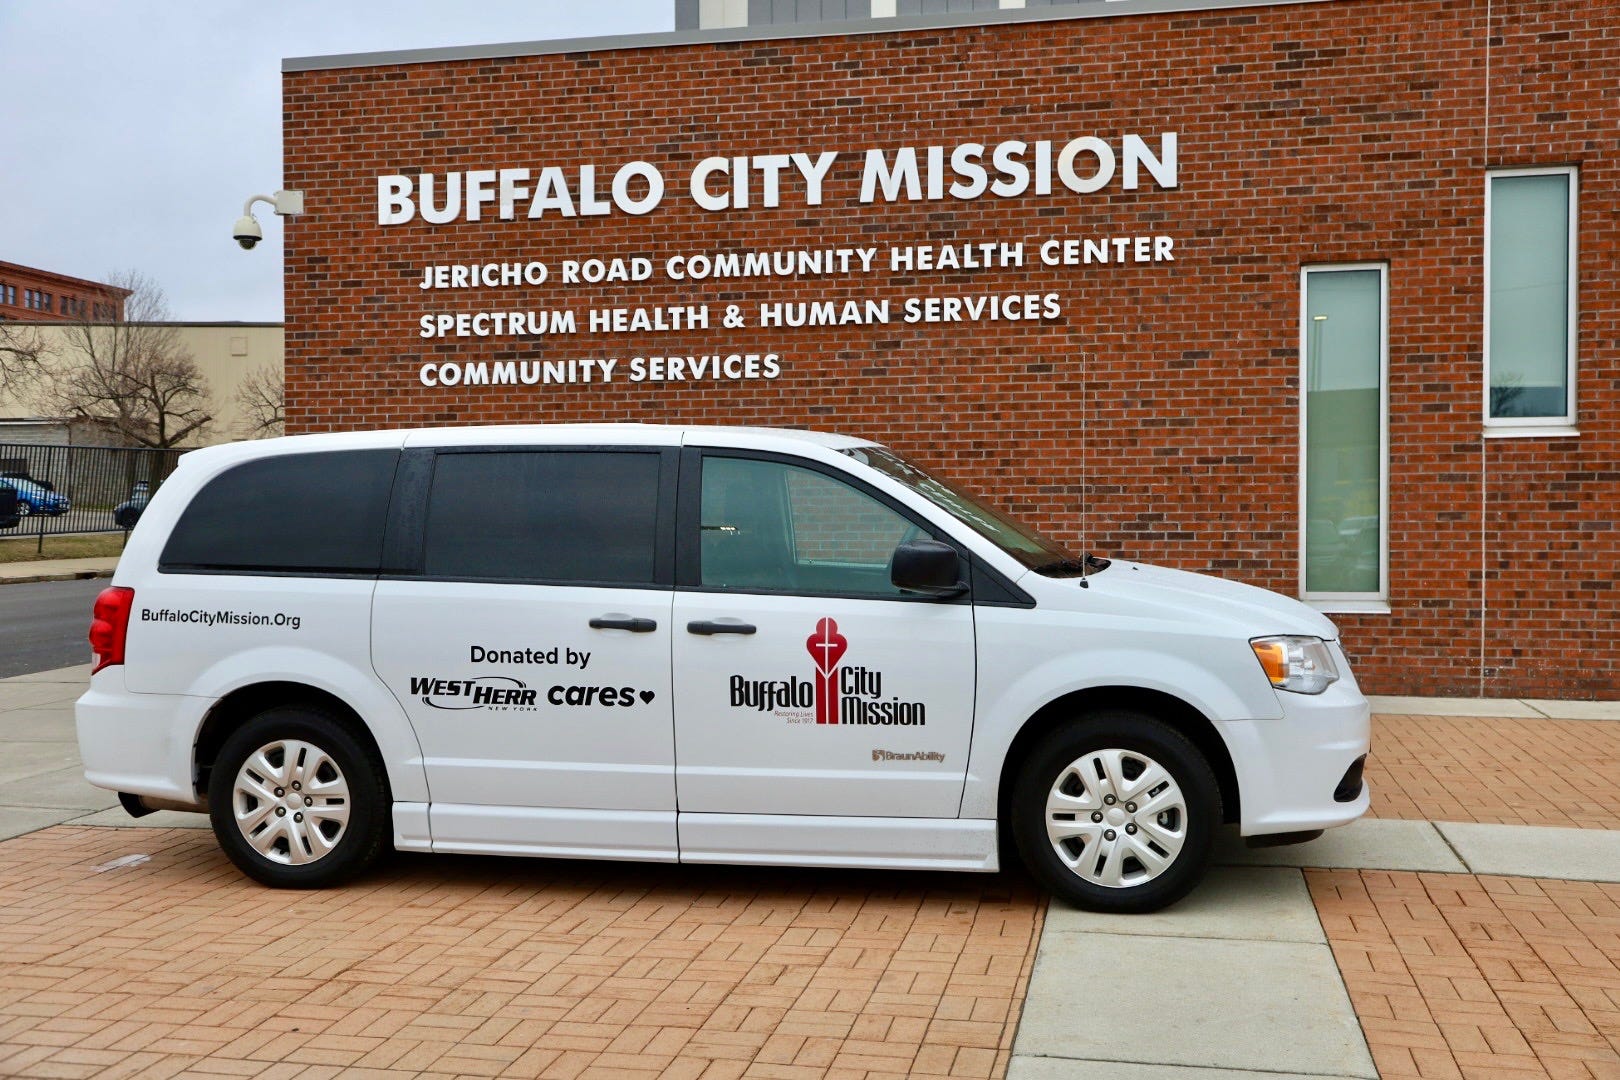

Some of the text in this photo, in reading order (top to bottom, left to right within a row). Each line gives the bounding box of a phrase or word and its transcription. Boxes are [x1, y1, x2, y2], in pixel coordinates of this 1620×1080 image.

[377, 131, 1178, 226] BUFFALO CITY MISSION
[419, 235, 1175, 290] JERICHO ROAD COMMUNITY HEALTH CENTER
[419, 293, 1062, 338] SPECTRUM HEALTH & HUMAN SERVICES
[419, 353, 781, 387] COMMUNITY SERVICES
[141, 608, 301, 630] BuffaloCityMission.Org
[470, 645, 591, 670] Donated by
[547, 685, 635, 707] cares
[729, 674, 814, 712] Buffalo
[840, 666, 882, 699] City
[841, 696, 926, 726] Mission
[885, 751, 946, 763] BraunAbility
